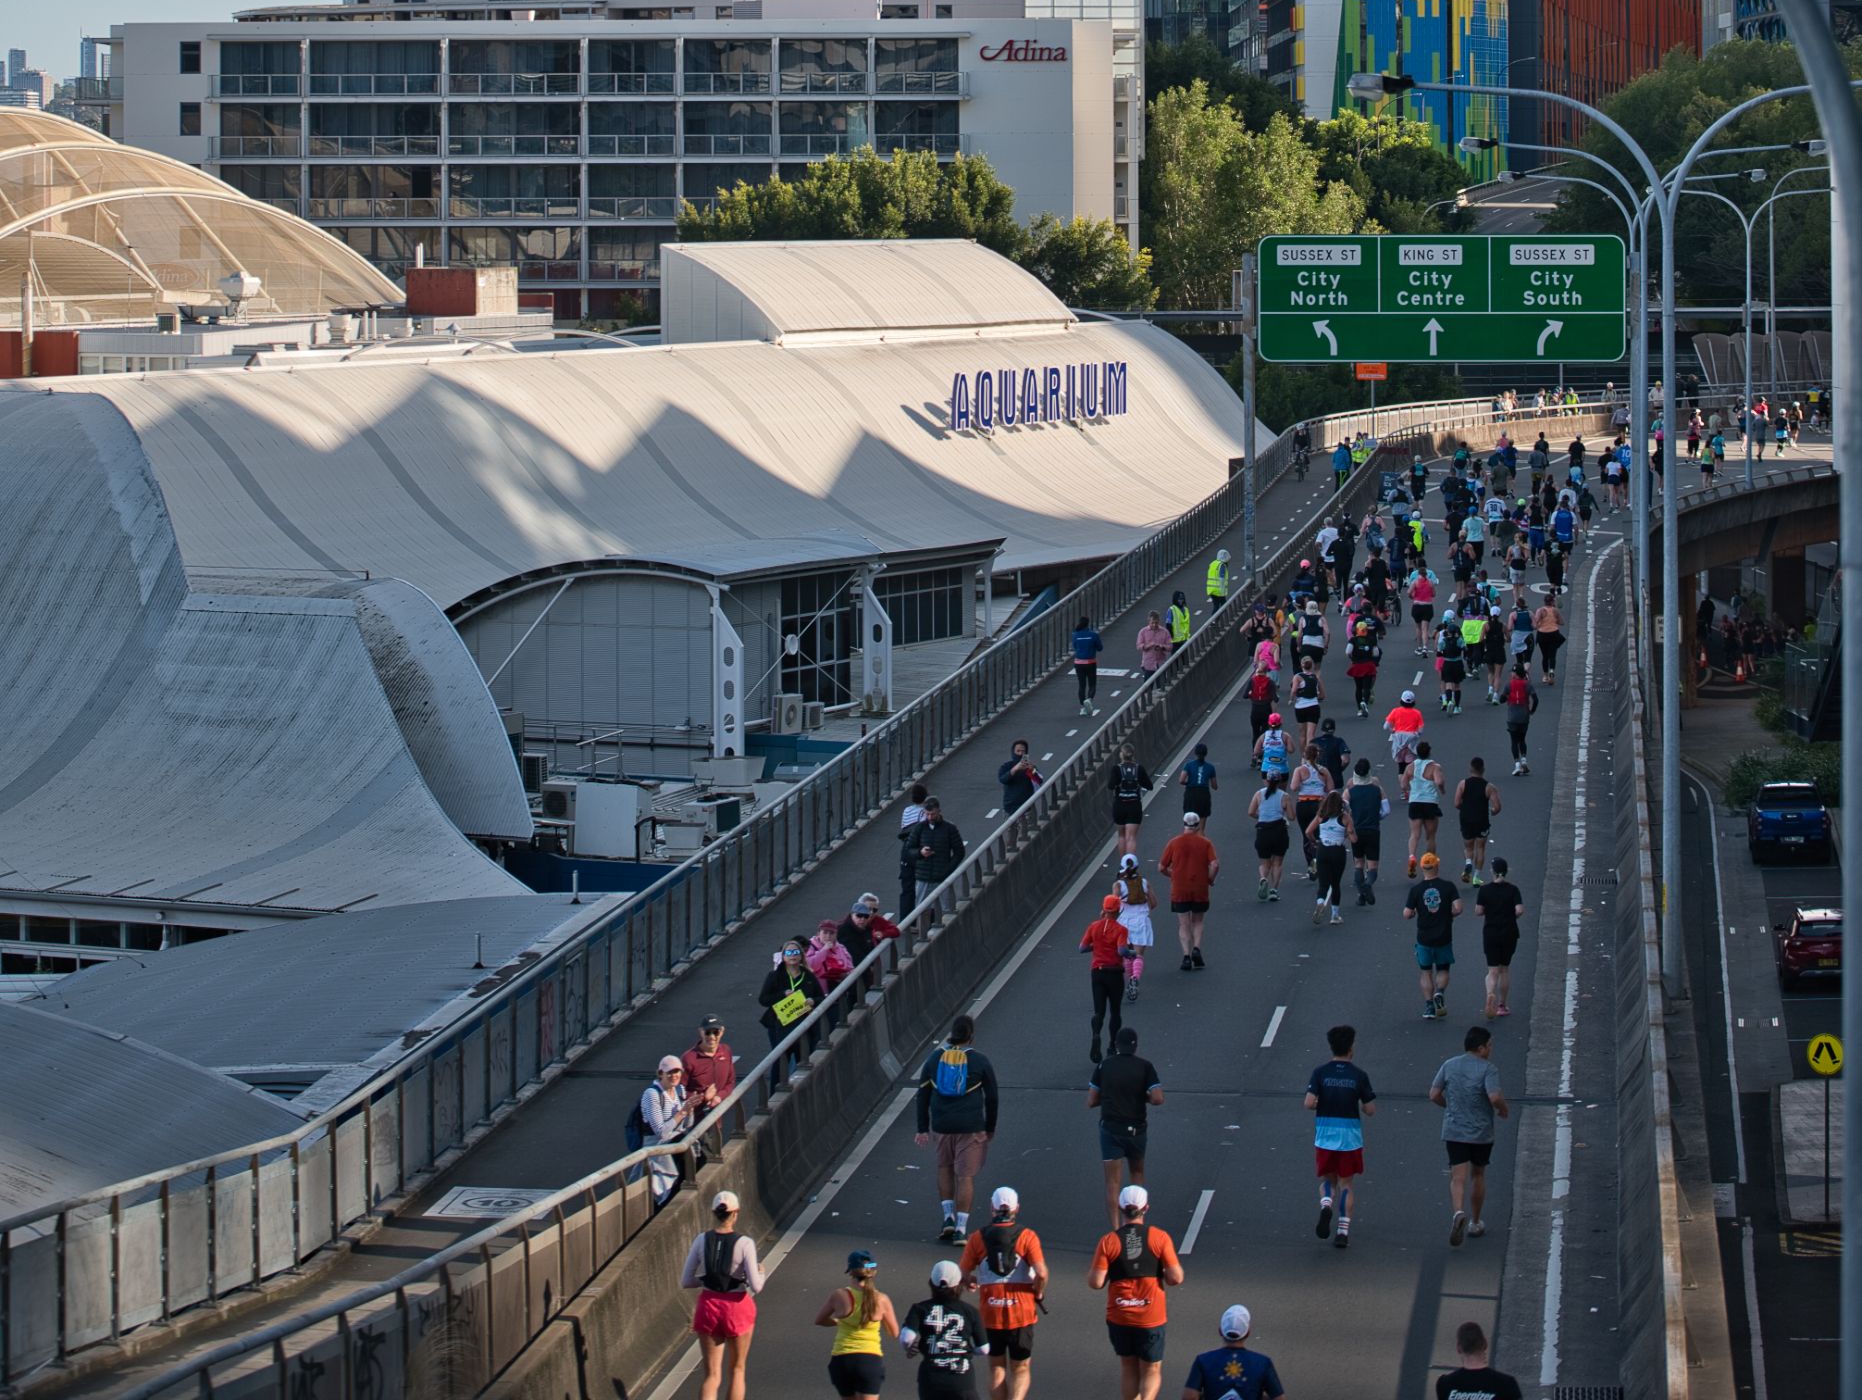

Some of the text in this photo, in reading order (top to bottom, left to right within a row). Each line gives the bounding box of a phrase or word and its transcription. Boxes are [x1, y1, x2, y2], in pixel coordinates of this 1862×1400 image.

[980, 40, 1067, 62] Adina
[1281, 249, 1357, 262] SUSSEX ST
[1403, 249, 1458, 262] KING ST
[1514, 249, 1590, 262] SUSSEX ST
[1297, 271, 1341, 288] City
[1409, 271, 1453, 288] City
[1530, 271, 1574, 288] City
[1290, 291, 1349, 306] North
[1397, 291, 1465, 306] Centre
[1523, 291, 1583, 306] South
[952, 361, 1128, 431] AQUARIUM
[925, 1305, 964, 1342] 42
[1448, 1389, 1495, 1400] Energizer
